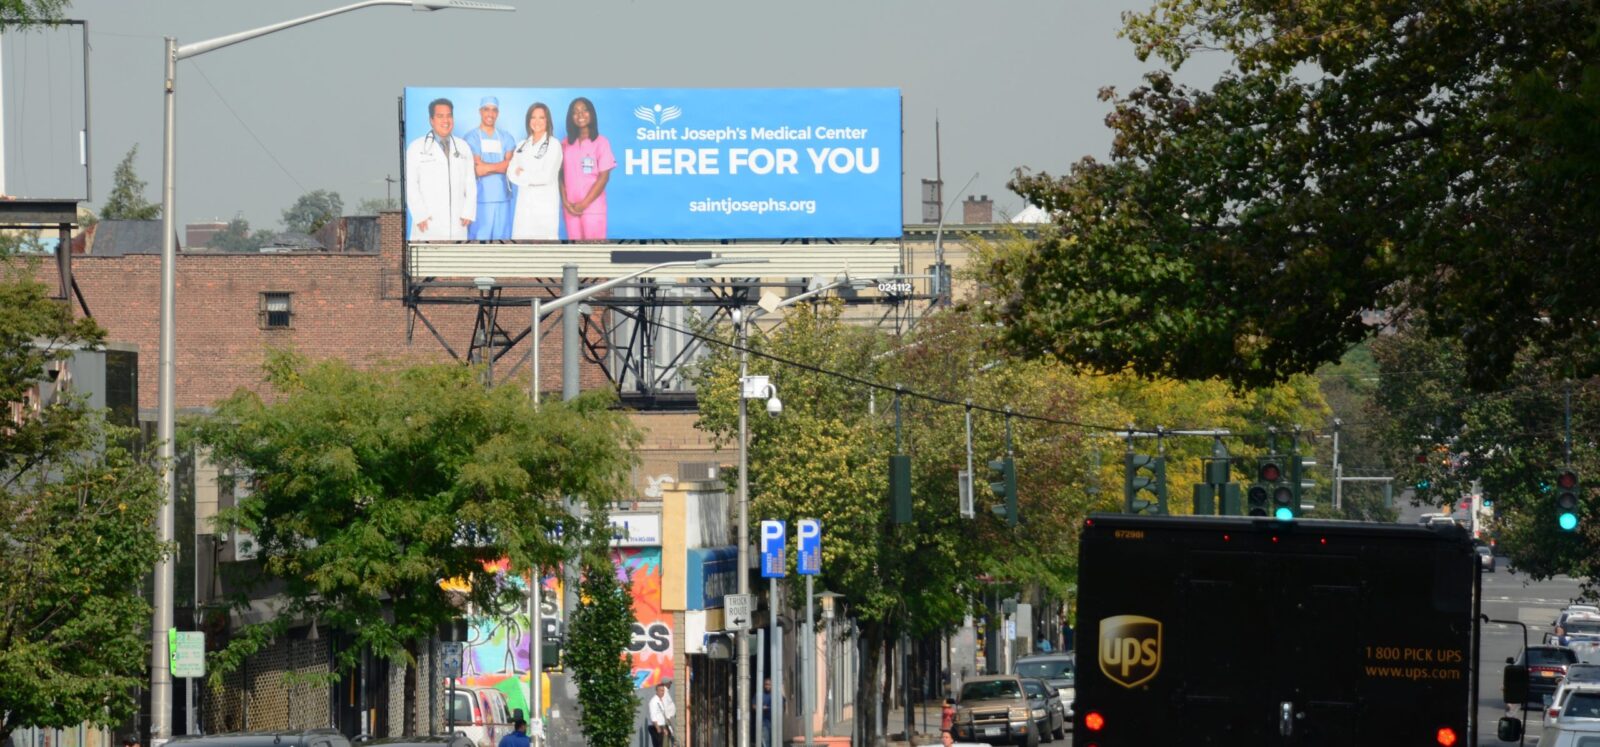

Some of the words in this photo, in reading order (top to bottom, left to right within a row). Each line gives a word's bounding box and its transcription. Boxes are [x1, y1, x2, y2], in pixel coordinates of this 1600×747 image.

[636, 126, 677, 140] Saint
[681, 126, 747, 144] Joseph's
[751, 126, 811, 141] Medical
[815, 126, 867, 140] Center
[625, 148, 719, 175] HERE
[729, 148, 798, 176] FOR
[807, 147, 879, 175] YOU
[689, 198, 816, 215] saintjosephs.org
[878, 283, 912, 293] 024112
[761, 521, 783, 552] P
[797, 520, 819, 550] P
[729, 597, 747, 606] TRUCK
[729, 607, 748, 616] ROUTE
[1103, 637, 1157, 677] ups
[1365, 646, 1372, 659] 1
[1375, 646, 1400, 660] 800
[1404, 648, 1433, 661] PICK
[1437, 649, 1462, 662] UPS
[1365, 665, 1460, 680] www.ups.com
